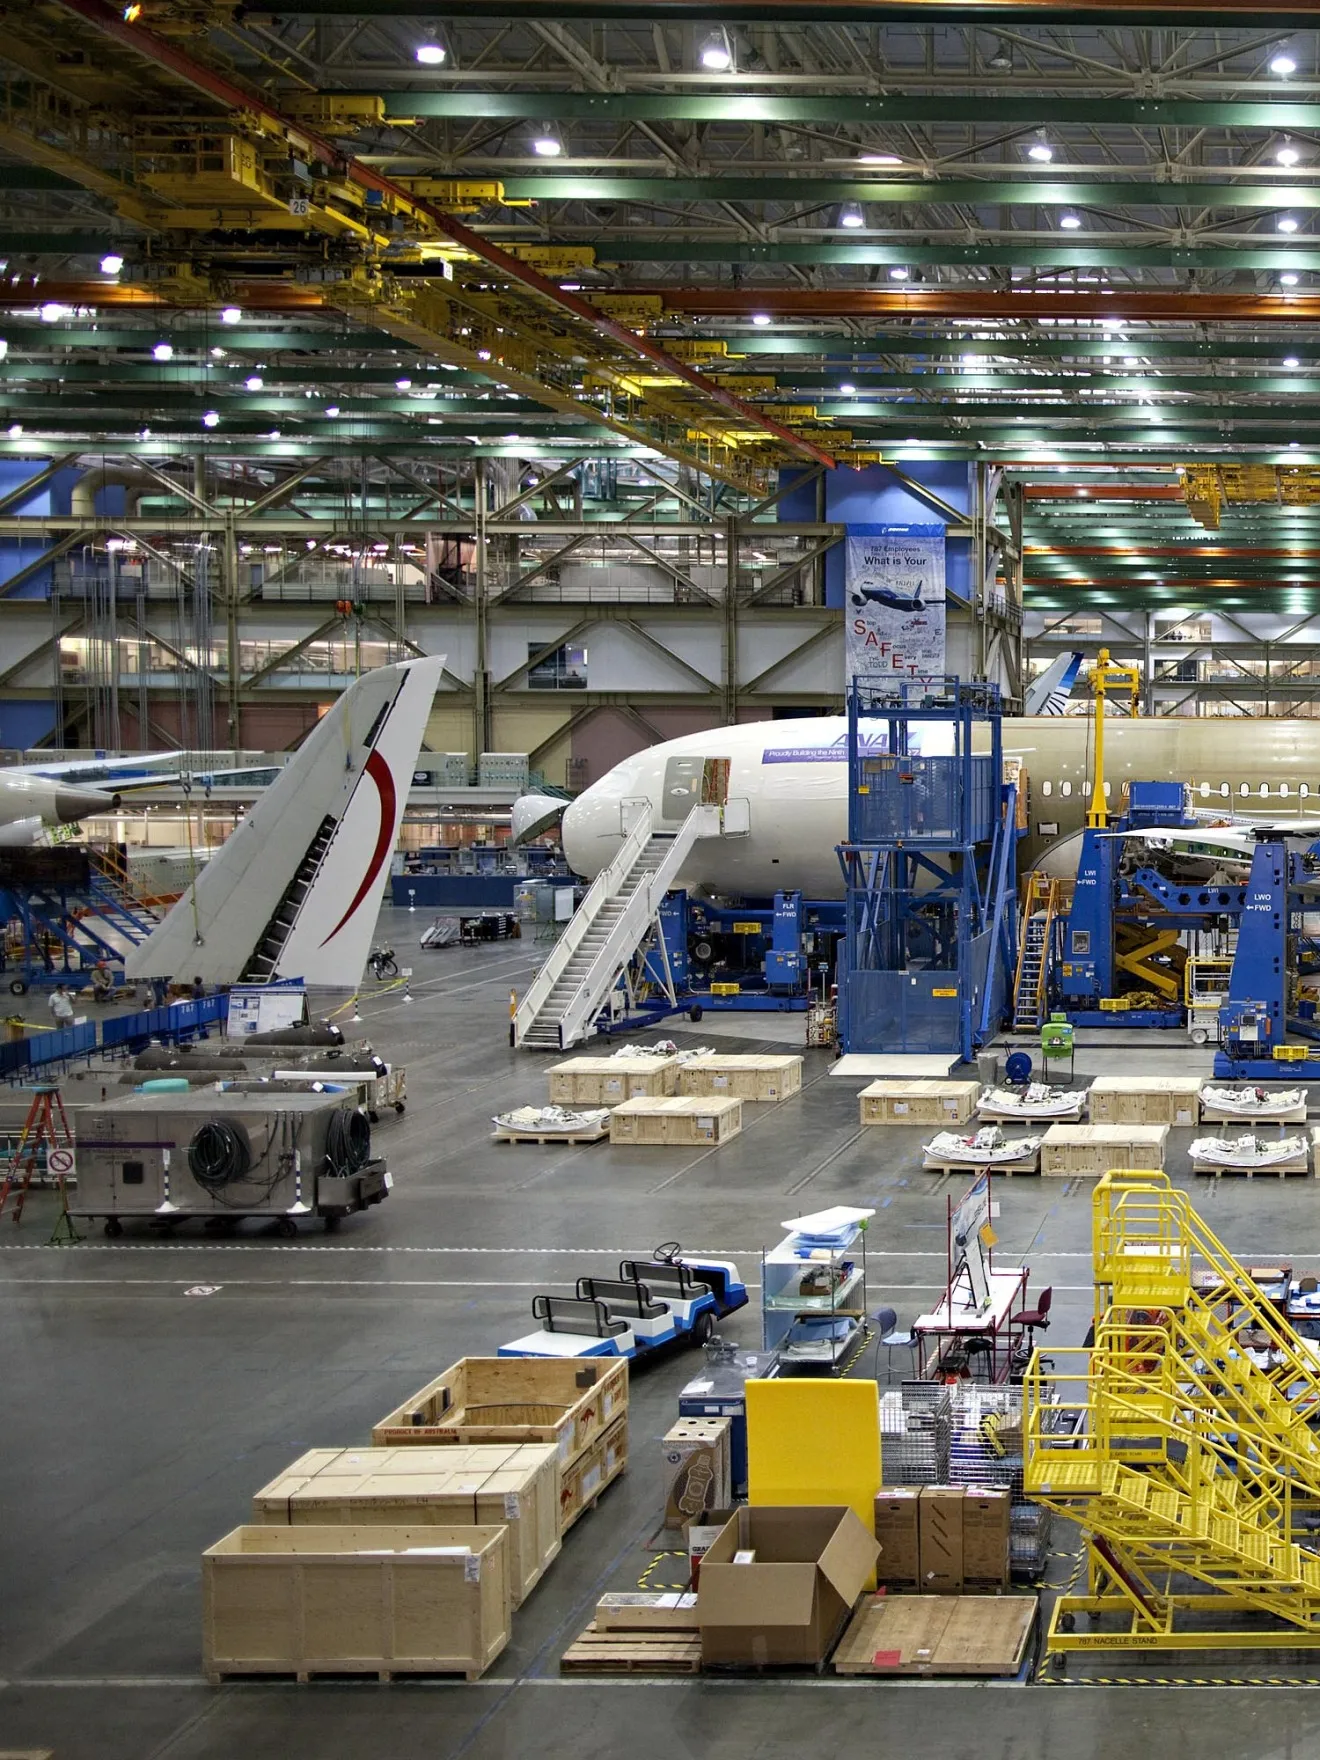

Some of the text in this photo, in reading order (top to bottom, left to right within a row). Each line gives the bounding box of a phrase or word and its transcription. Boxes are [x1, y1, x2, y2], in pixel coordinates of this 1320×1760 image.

[293, 200, 306, 214] 26
[864, 556, 927, 565] What is Your
[1254, 893, 1272, 901] LWO
[1254, 904, 1272, 912] FWD
[202, 999, 215, 1009] 787
[181, 1004, 195, 1014] 787
[1078, 1636, 1158, 1645] 787 NACELLE STAND
